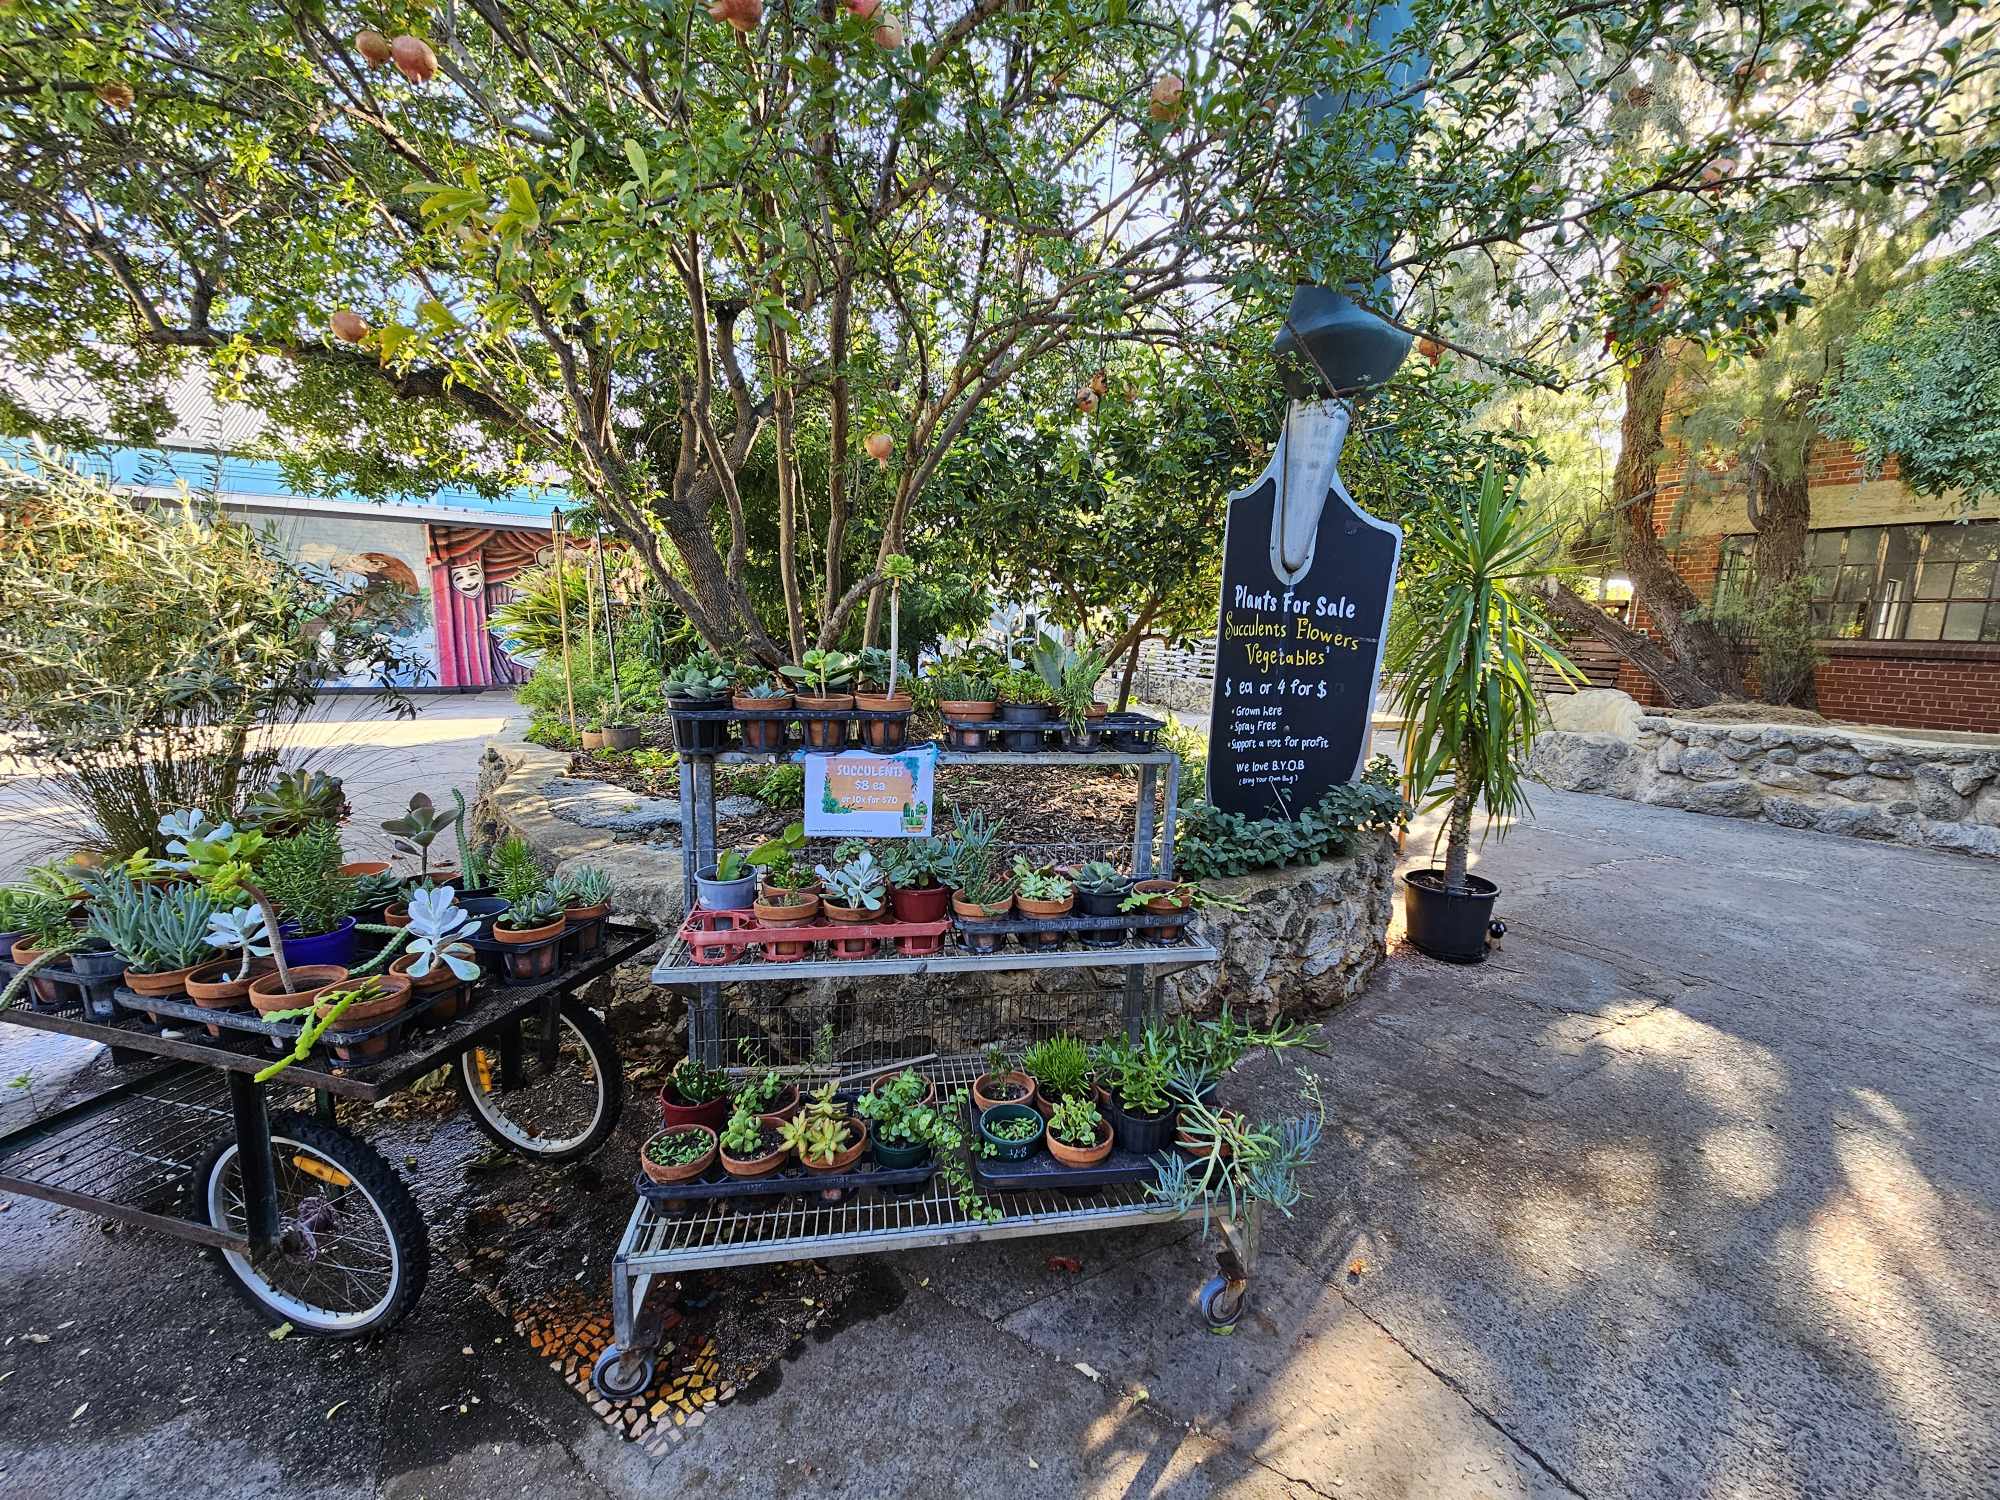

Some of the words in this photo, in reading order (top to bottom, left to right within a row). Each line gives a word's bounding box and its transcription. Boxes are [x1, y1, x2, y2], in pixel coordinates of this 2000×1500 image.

[1234, 584, 1278, 613] Plants
[1283, 591, 1311, 614] For
[1315, 595, 1356, 619] Sale
[1224, 610, 1287, 641] Succulents
[1295, 617, 1359, 651] Flowers
[1224, 676, 1232, 698] $
[1239, 680, 1253, 695] ea
[1259, 682, 1272, 695] or
[1277, 678, 1286, 695] 4
[1290, 678, 1314, 696] for
[1316, 679, 1327, 699] $
[1235, 705, 1261, 717] Grown
[1262, 706, 1283, 717] here
[1234, 720, 1255, 735] Spray
[1257, 720, 1277, 731] Free
[1231, 738, 1257, 752] Support
[1266, 739, 1282, 749] not
[1284, 735, 1300, 748] for
[1301, 735, 1329, 750] profit
[836, 764, 904, 777] SUCCULENTS
[1236, 761, 1250, 773] We
[1252, 760, 1269, 772] love
[1271, 759, 1305, 772] B.Y.O.B
[854, 778, 870, 791] $8
[872, 782, 886, 791] ea
